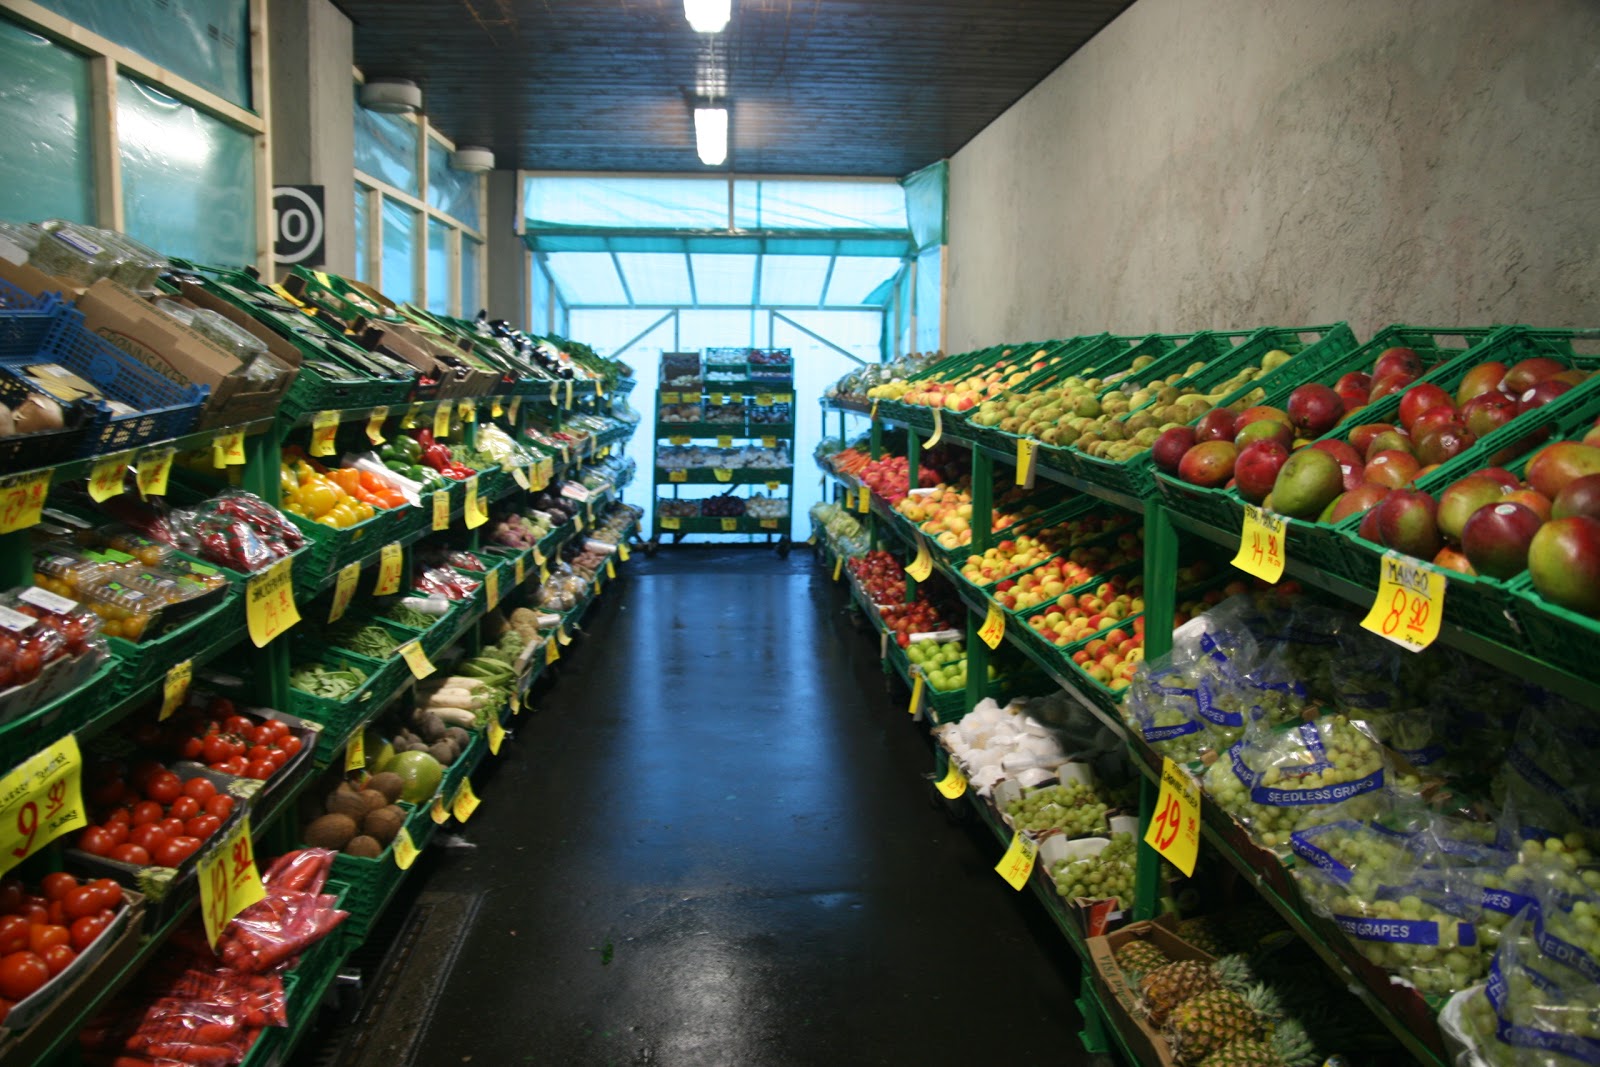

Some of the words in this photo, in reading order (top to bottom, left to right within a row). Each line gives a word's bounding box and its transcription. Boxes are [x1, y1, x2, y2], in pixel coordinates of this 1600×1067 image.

[1388, 560, 1429, 592] MANGO
[1382, 587, 1407, 635] 8
[1410, 597, 1429, 627] 90
[1267, 789, 1331, 803] SEEDLESS
[1332, 779, 1374, 799] GRAPES
[12, 801, 39, 858] 9
[1155, 793, 1181, 851] 19
[208, 858, 229, 938] 19
[1357, 922, 1410, 938] GRAPES
